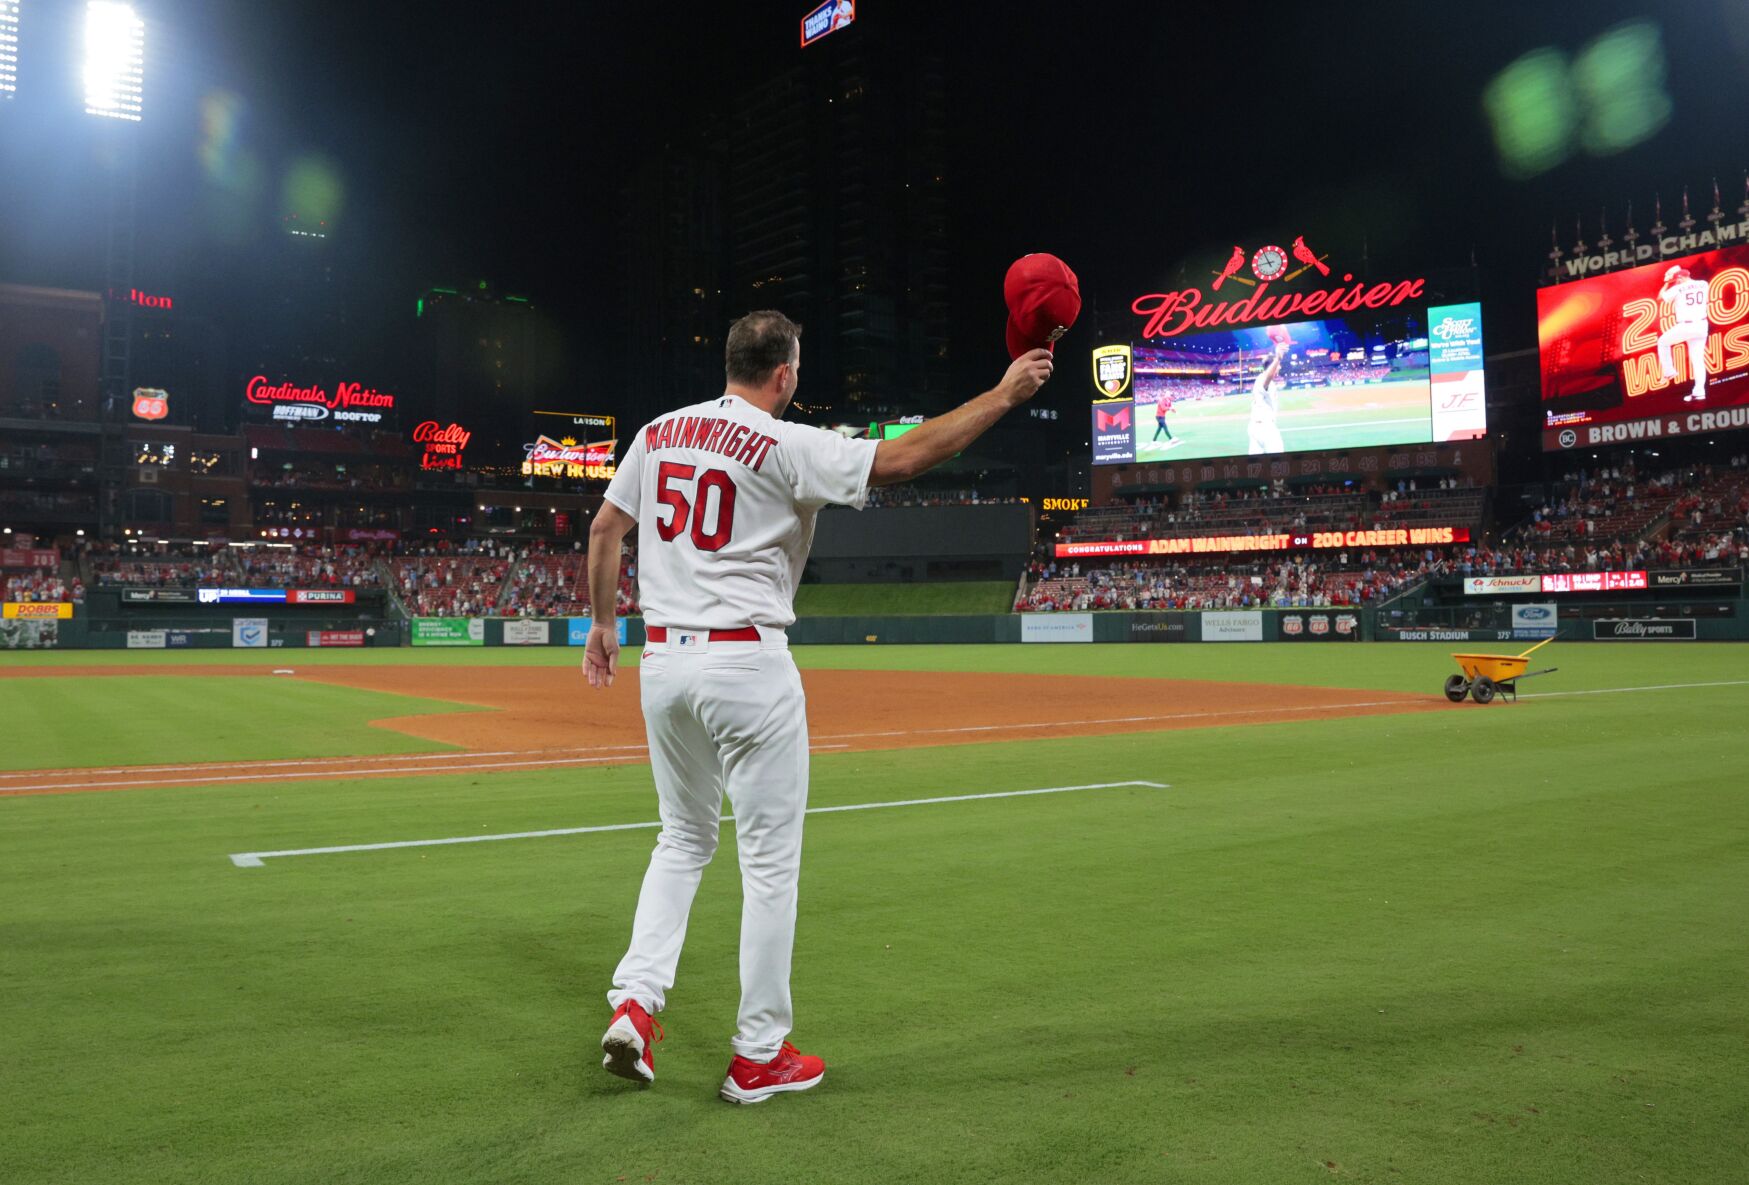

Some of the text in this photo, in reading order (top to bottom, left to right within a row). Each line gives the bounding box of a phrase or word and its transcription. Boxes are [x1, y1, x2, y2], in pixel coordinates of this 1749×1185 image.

[805, 6, 832, 30] THANKS
[806, 18, 829, 39] WAINO
[1565, 244, 1653, 276] WORLD
[110, 288, 173, 310] lton
[1131, 272, 1426, 339] Budweiser
[1685, 290, 1704, 306] 50
[246, 375, 394, 409] Cardinals Nation
[137, 399, 162, 414] 66
[334, 410, 382, 422] ROOFTOP
[1589, 408, 1749, 444] BROWN & CROU
[413, 420, 471, 449] Bally
[1098, 434, 1130, 442] MARYVILLE
[1562, 433, 1575, 443] BC
[425, 444, 457, 454] SPORTS
[645, 416, 779, 473] WAINWRIGHT
[523, 442, 615, 463] Budweiser
[421, 453, 463, 469] Live!
[1182, 467, 1192, 482] 9
[1200, 466, 1215, 481] 10
[1223, 464, 1239, 479] 14
[1246, 462, 1262, 478] 17
[1270, 461, 1290, 477] 20
[1301, 459, 1321, 475] 23
[1328, 456, 1349, 473] 24
[1358, 455, 1378, 472] 42
[522, 462, 564, 476] BREW
[656, 460, 737, 552] 50
[1068, 543, 1143, 554] CONGRATULATIONS
[1149, 539, 1191, 554] ADAM
[1191, 534, 1290, 553] WAINWRIGHT
[1312, 532, 1344, 548] 200
[1346, 529, 1408, 547] CAREER
[1410, 527, 1454, 544] WINS
[1487, 577, 1536, 587] Schnucks
[1657, 575, 1681, 585] Mercy
[130, 591, 149, 600] Mercy
[308, 592, 342, 600] PURINA
[18, 604, 59, 614] DOBBS
[1523, 609, 1545, 619] Ford
[1132, 623, 1184, 632] HeGetsUs.com
[1286, 623, 1299, 631] 66
[1313, 623, 1325, 631] 66
[1614, 621, 1673, 637] Bally SPORTS
[1400, 631, 1469, 640] BUSCH STADIUM
[1497, 631, 1511, 640] 375'
